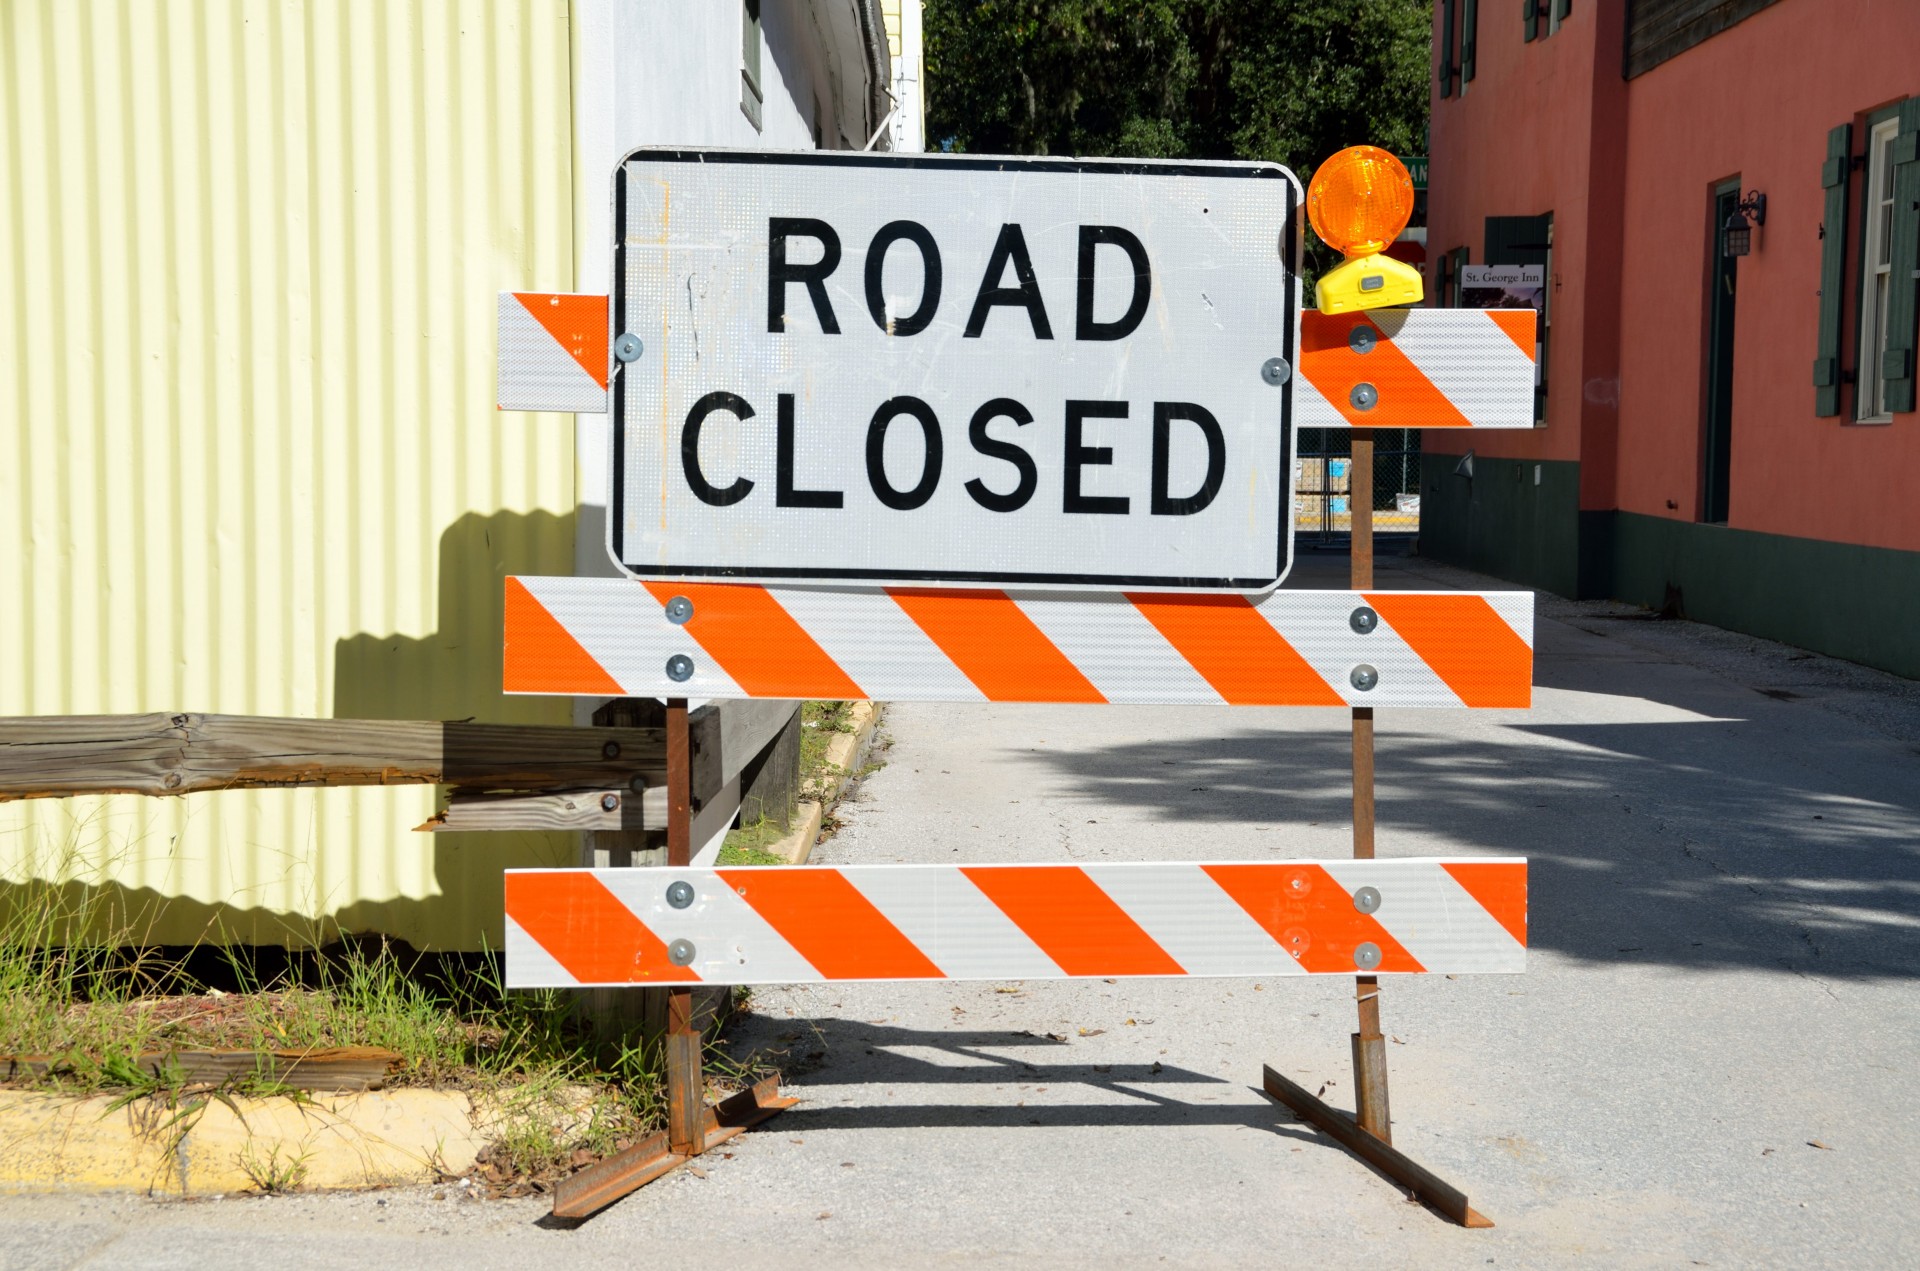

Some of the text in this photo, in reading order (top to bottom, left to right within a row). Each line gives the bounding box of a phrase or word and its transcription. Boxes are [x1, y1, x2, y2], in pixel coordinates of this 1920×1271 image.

[1406, 164, 1427, 182] AN
[767, 217, 1151, 341] ROAD
[1466, 272, 1539, 284] St. George Inn
[681, 391, 1225, 515] CLOSED
